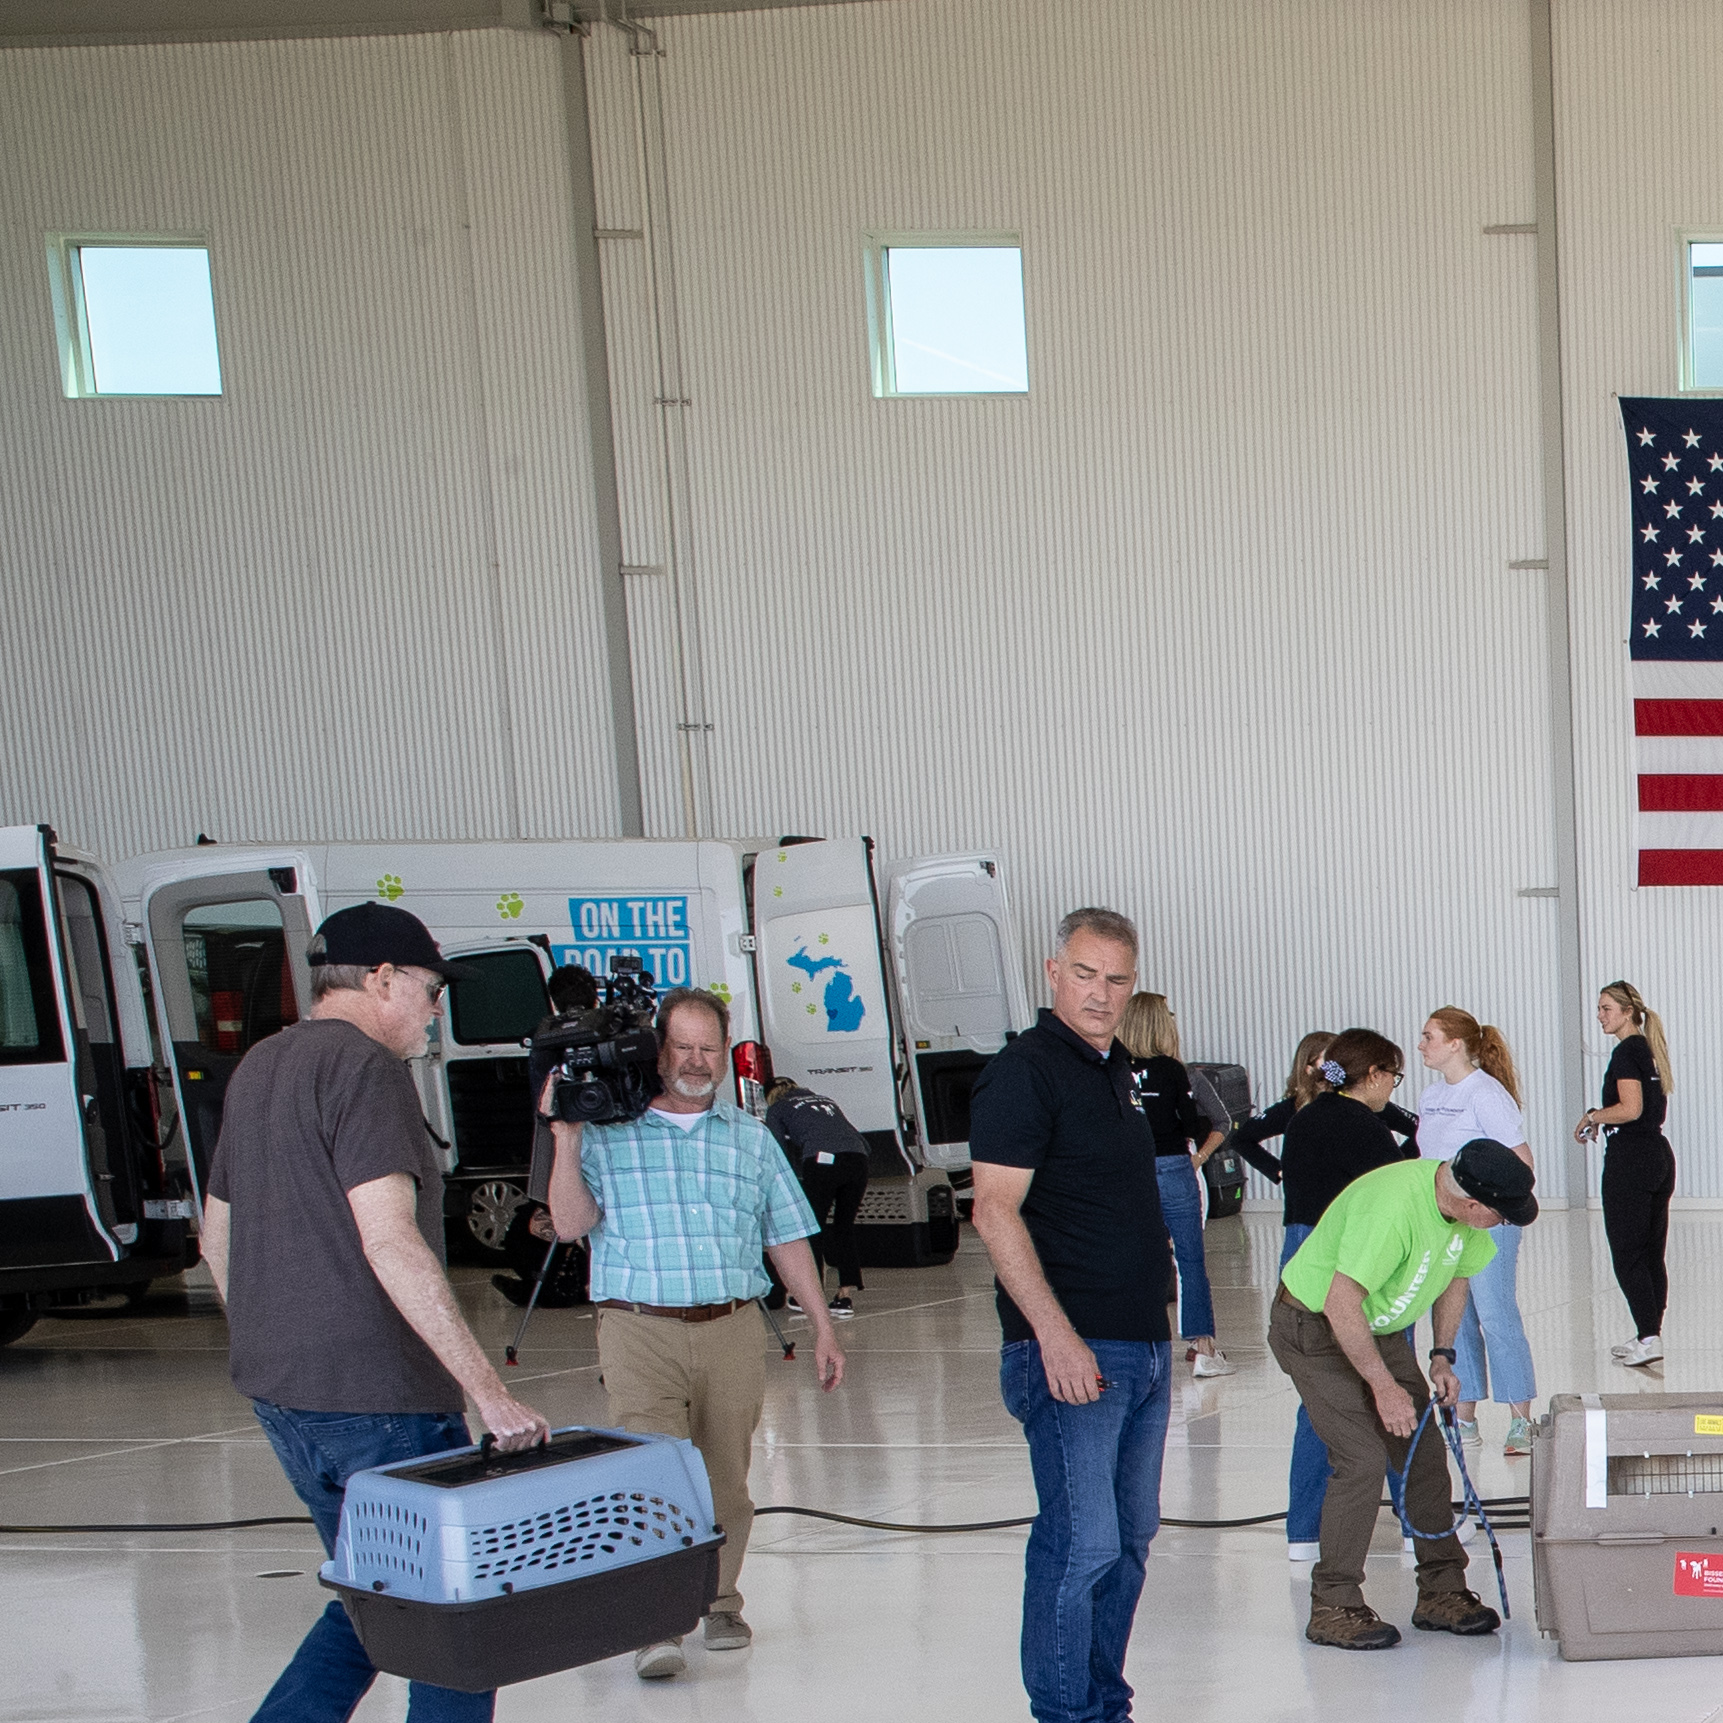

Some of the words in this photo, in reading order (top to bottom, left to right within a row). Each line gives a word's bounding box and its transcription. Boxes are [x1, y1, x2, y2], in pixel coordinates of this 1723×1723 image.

[580, 901, 620, 938] ON
[626, 900, 685, 937] THE
[564, 947, 641, 985] OA
[648, 948, 686, 985] TO
[807, 1066, 857, 1075] TRANSIT
[1370, 1250, 1431, 1331] OLUNTEER
